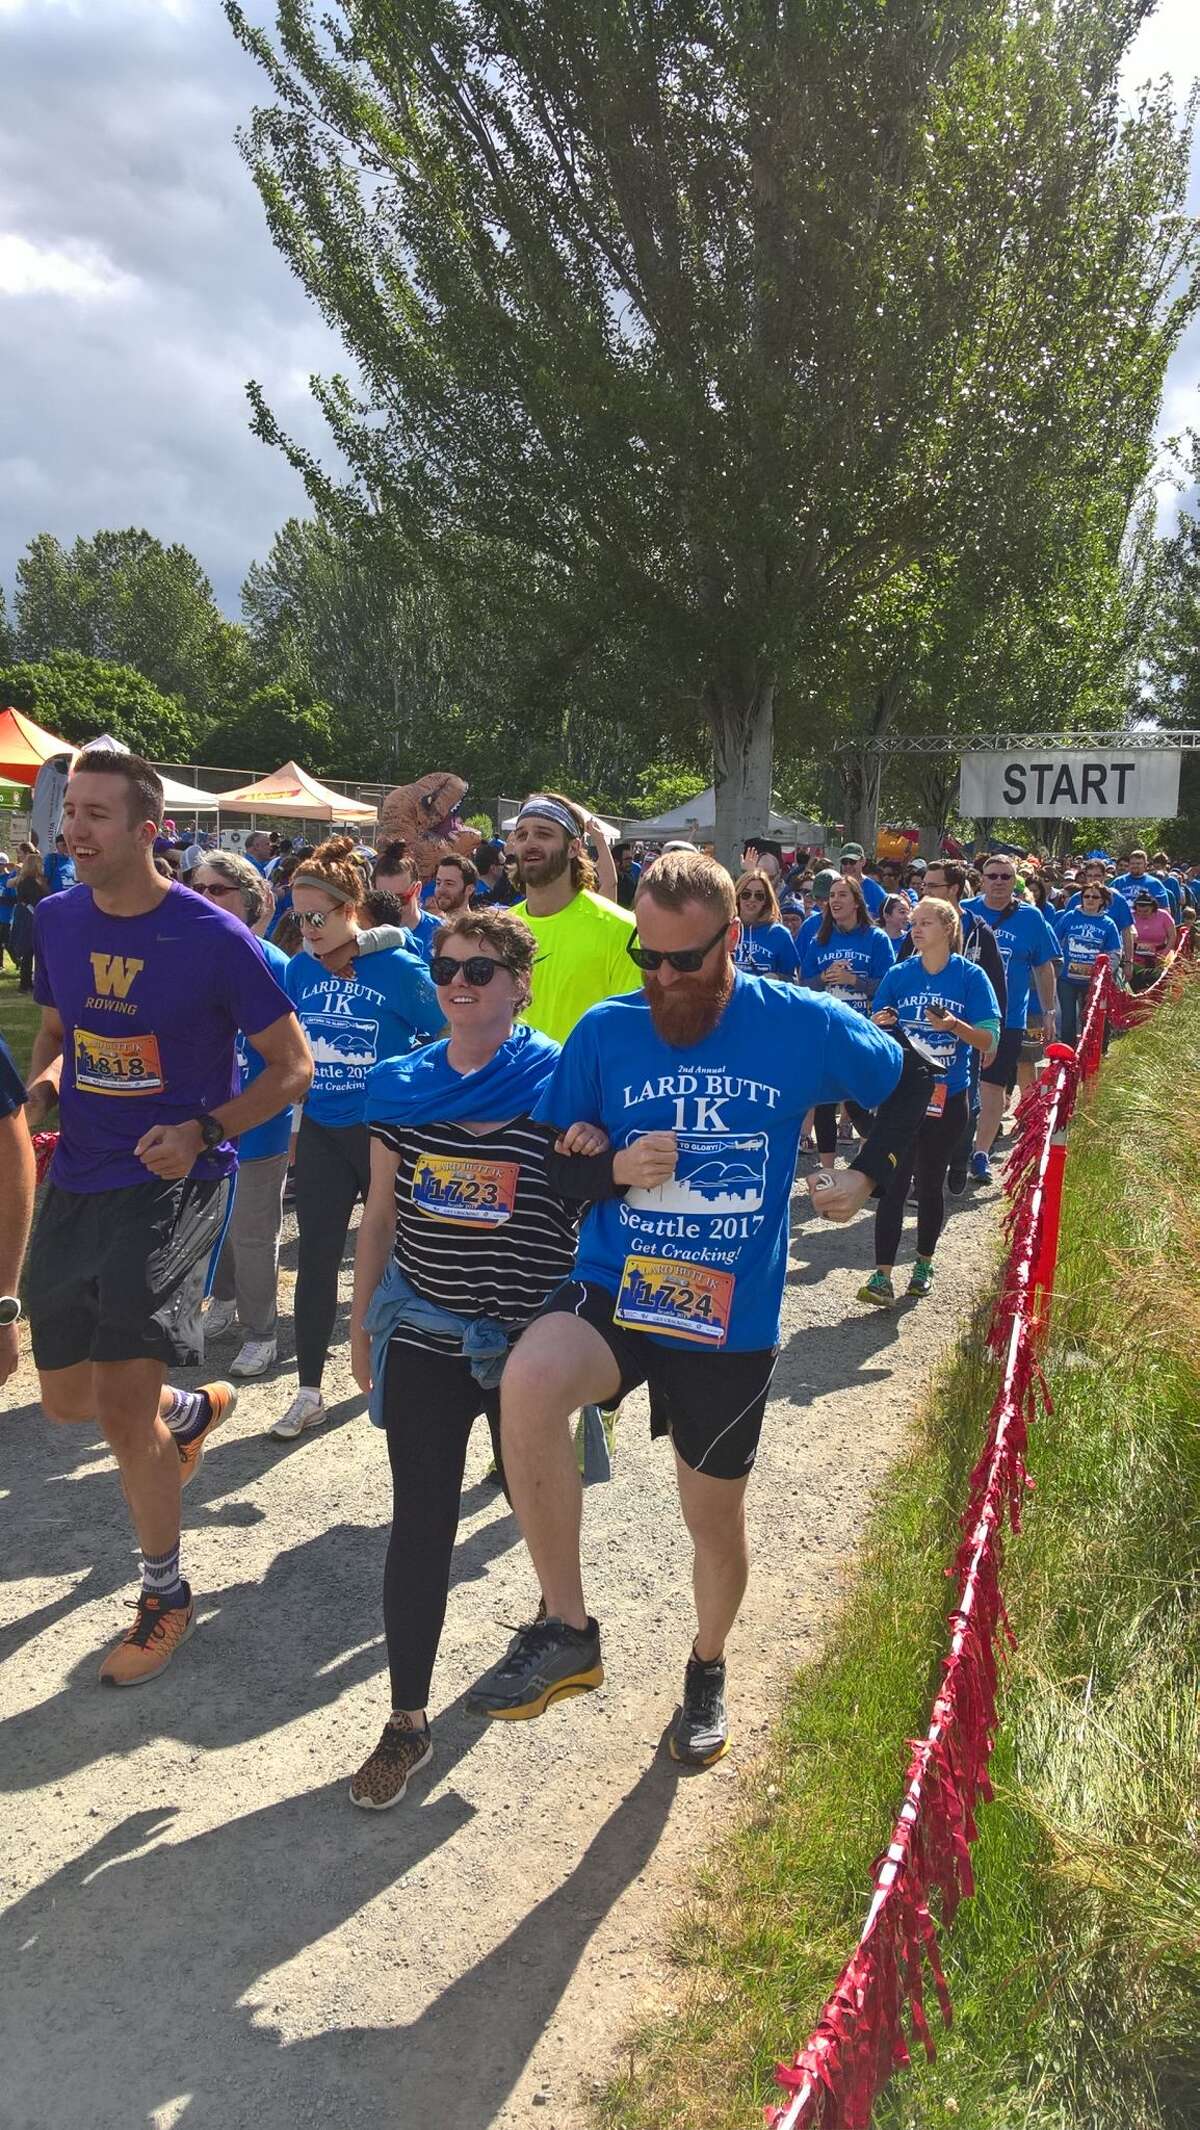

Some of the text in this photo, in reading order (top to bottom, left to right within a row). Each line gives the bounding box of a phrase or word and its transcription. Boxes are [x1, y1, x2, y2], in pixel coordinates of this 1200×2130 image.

[1002, 763, 1136, 805] START
[816, 951, 871, 964] LARD BUTT
[89, 952, 145, 999] W
[302, 980, 387, 1006] LARD BUTT
[321, 993, 355, 1015] 1K
[897, 996, 928, 1008] LARD
[85, 997, 138, 1016] ROWING
[85, 1054, 146, 1078] 1818
[678, 1064, 726, 1074] 2nd Annual
[623, 1075, 781, 1109] LARD BUTT
[671, 1097, 730, 1132] 1K
[427, 1178, 499, 1204] 1723
[619, 1203, 765, 1240] Seattle 2017
[630, 1237, 742, 1265] Get Cracking!
[635, 1282, 713, 1318] 1724
